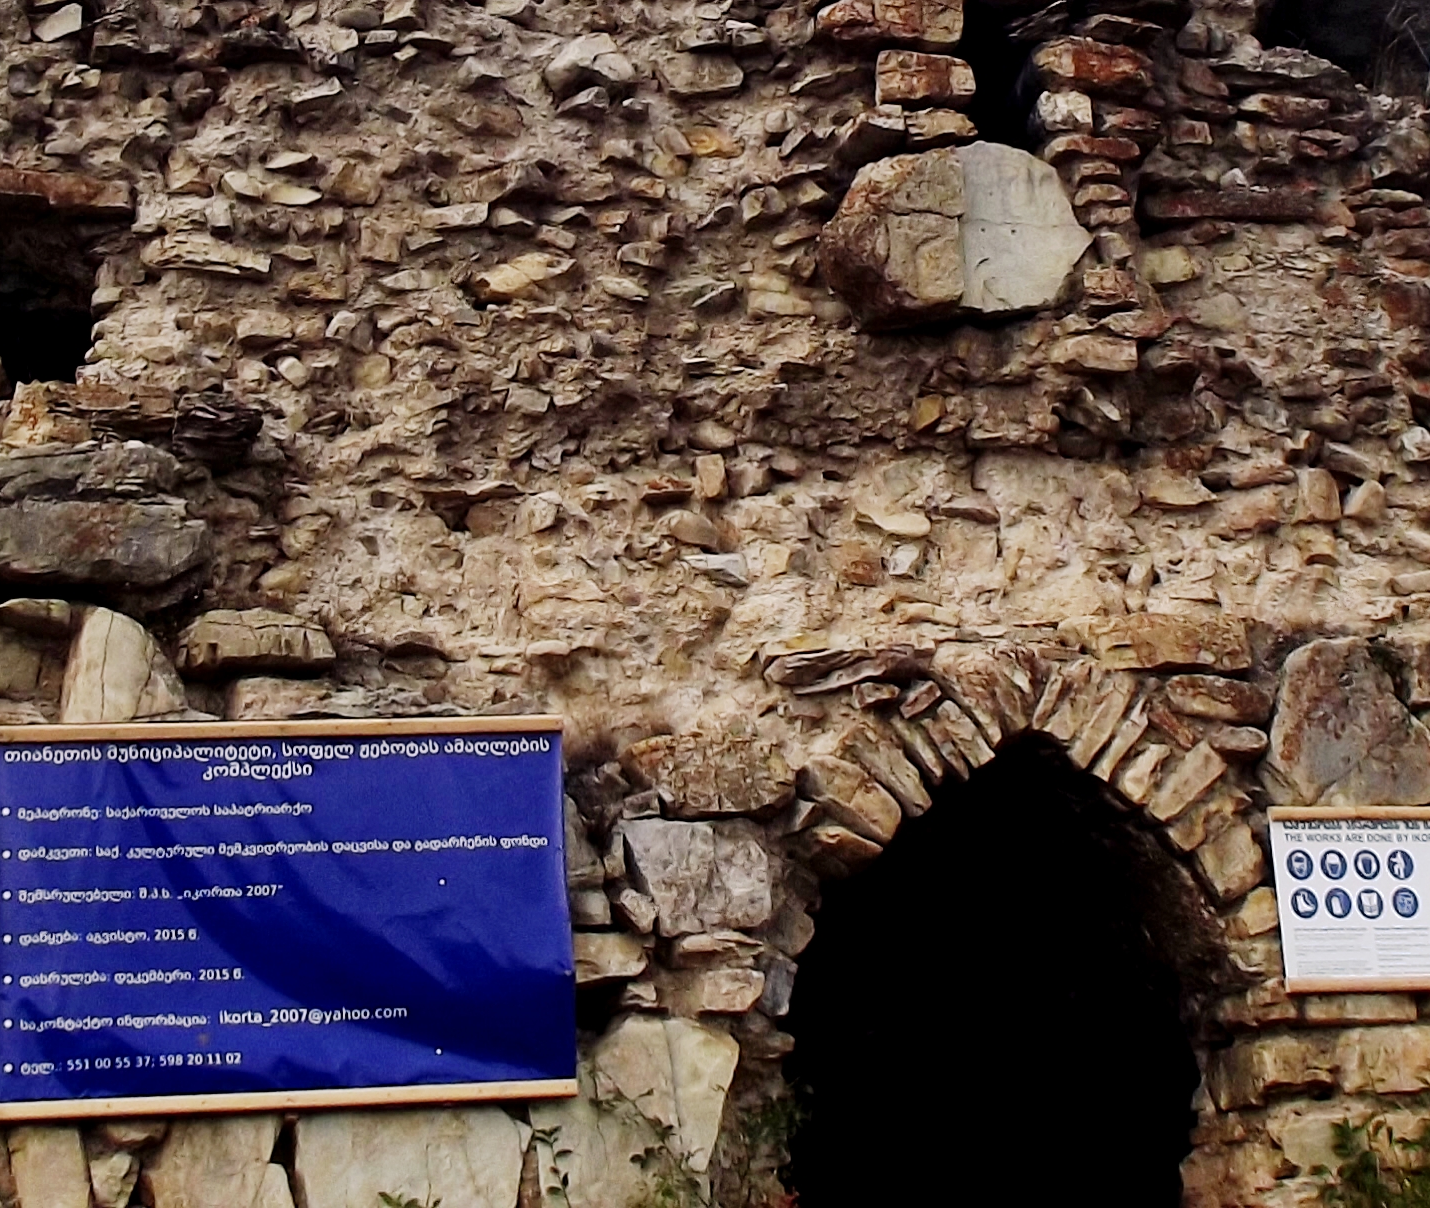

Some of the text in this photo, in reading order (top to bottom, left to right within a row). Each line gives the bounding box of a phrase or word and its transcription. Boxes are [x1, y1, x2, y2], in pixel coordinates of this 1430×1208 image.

[4, 738, 549, 764] თიანეთის მუნიციპალიტეტი, სოფელ ჟებოტას ამაღლების
[203, 762, 312, 780] კომპლექსი
[17, 803, 312, 822] მეპატრონე: საქართველოს საპატრიარქო
[1305, 833, 1342, 842] WORKS
[1397, 834, 1409, 842] BY
[18, 846, 92, 861] დამკვეთი:
[126, 844, 215, 859] კულტურული
[218, 841, 328, 857] მემკვიდრეობის
[332, 840, 389, 853] დაცვისა
[392, 841, 411, 852] და
[415, 836, 497, 851] გადარჩენის
[500, 835, 548, 849] ფონდი
[18, 889, 134, 904] შემსრულებელი:
[19, 931, 81, 946] დაწყება:
[155, 929, 184, 941] 2015
[19, 971, 109, 988] დასრულება:
[199, 969, 229, 980] 2015
[20, 1017, 113, 1032] საკონტაქტო
[117, 1014, 210, 1029] ინფორმაცია:
[67, 1059, 89, 1071] 551
[95, 1058, 111, 1069] 00
[115, 1057, 131, 1069] 55
[160, 1054, 183, 1066] 598
[187, 1054, 203, 1065] 20
[207, 1053, 221, 1065] 11
[226, 1053, 241, 1064] 02
